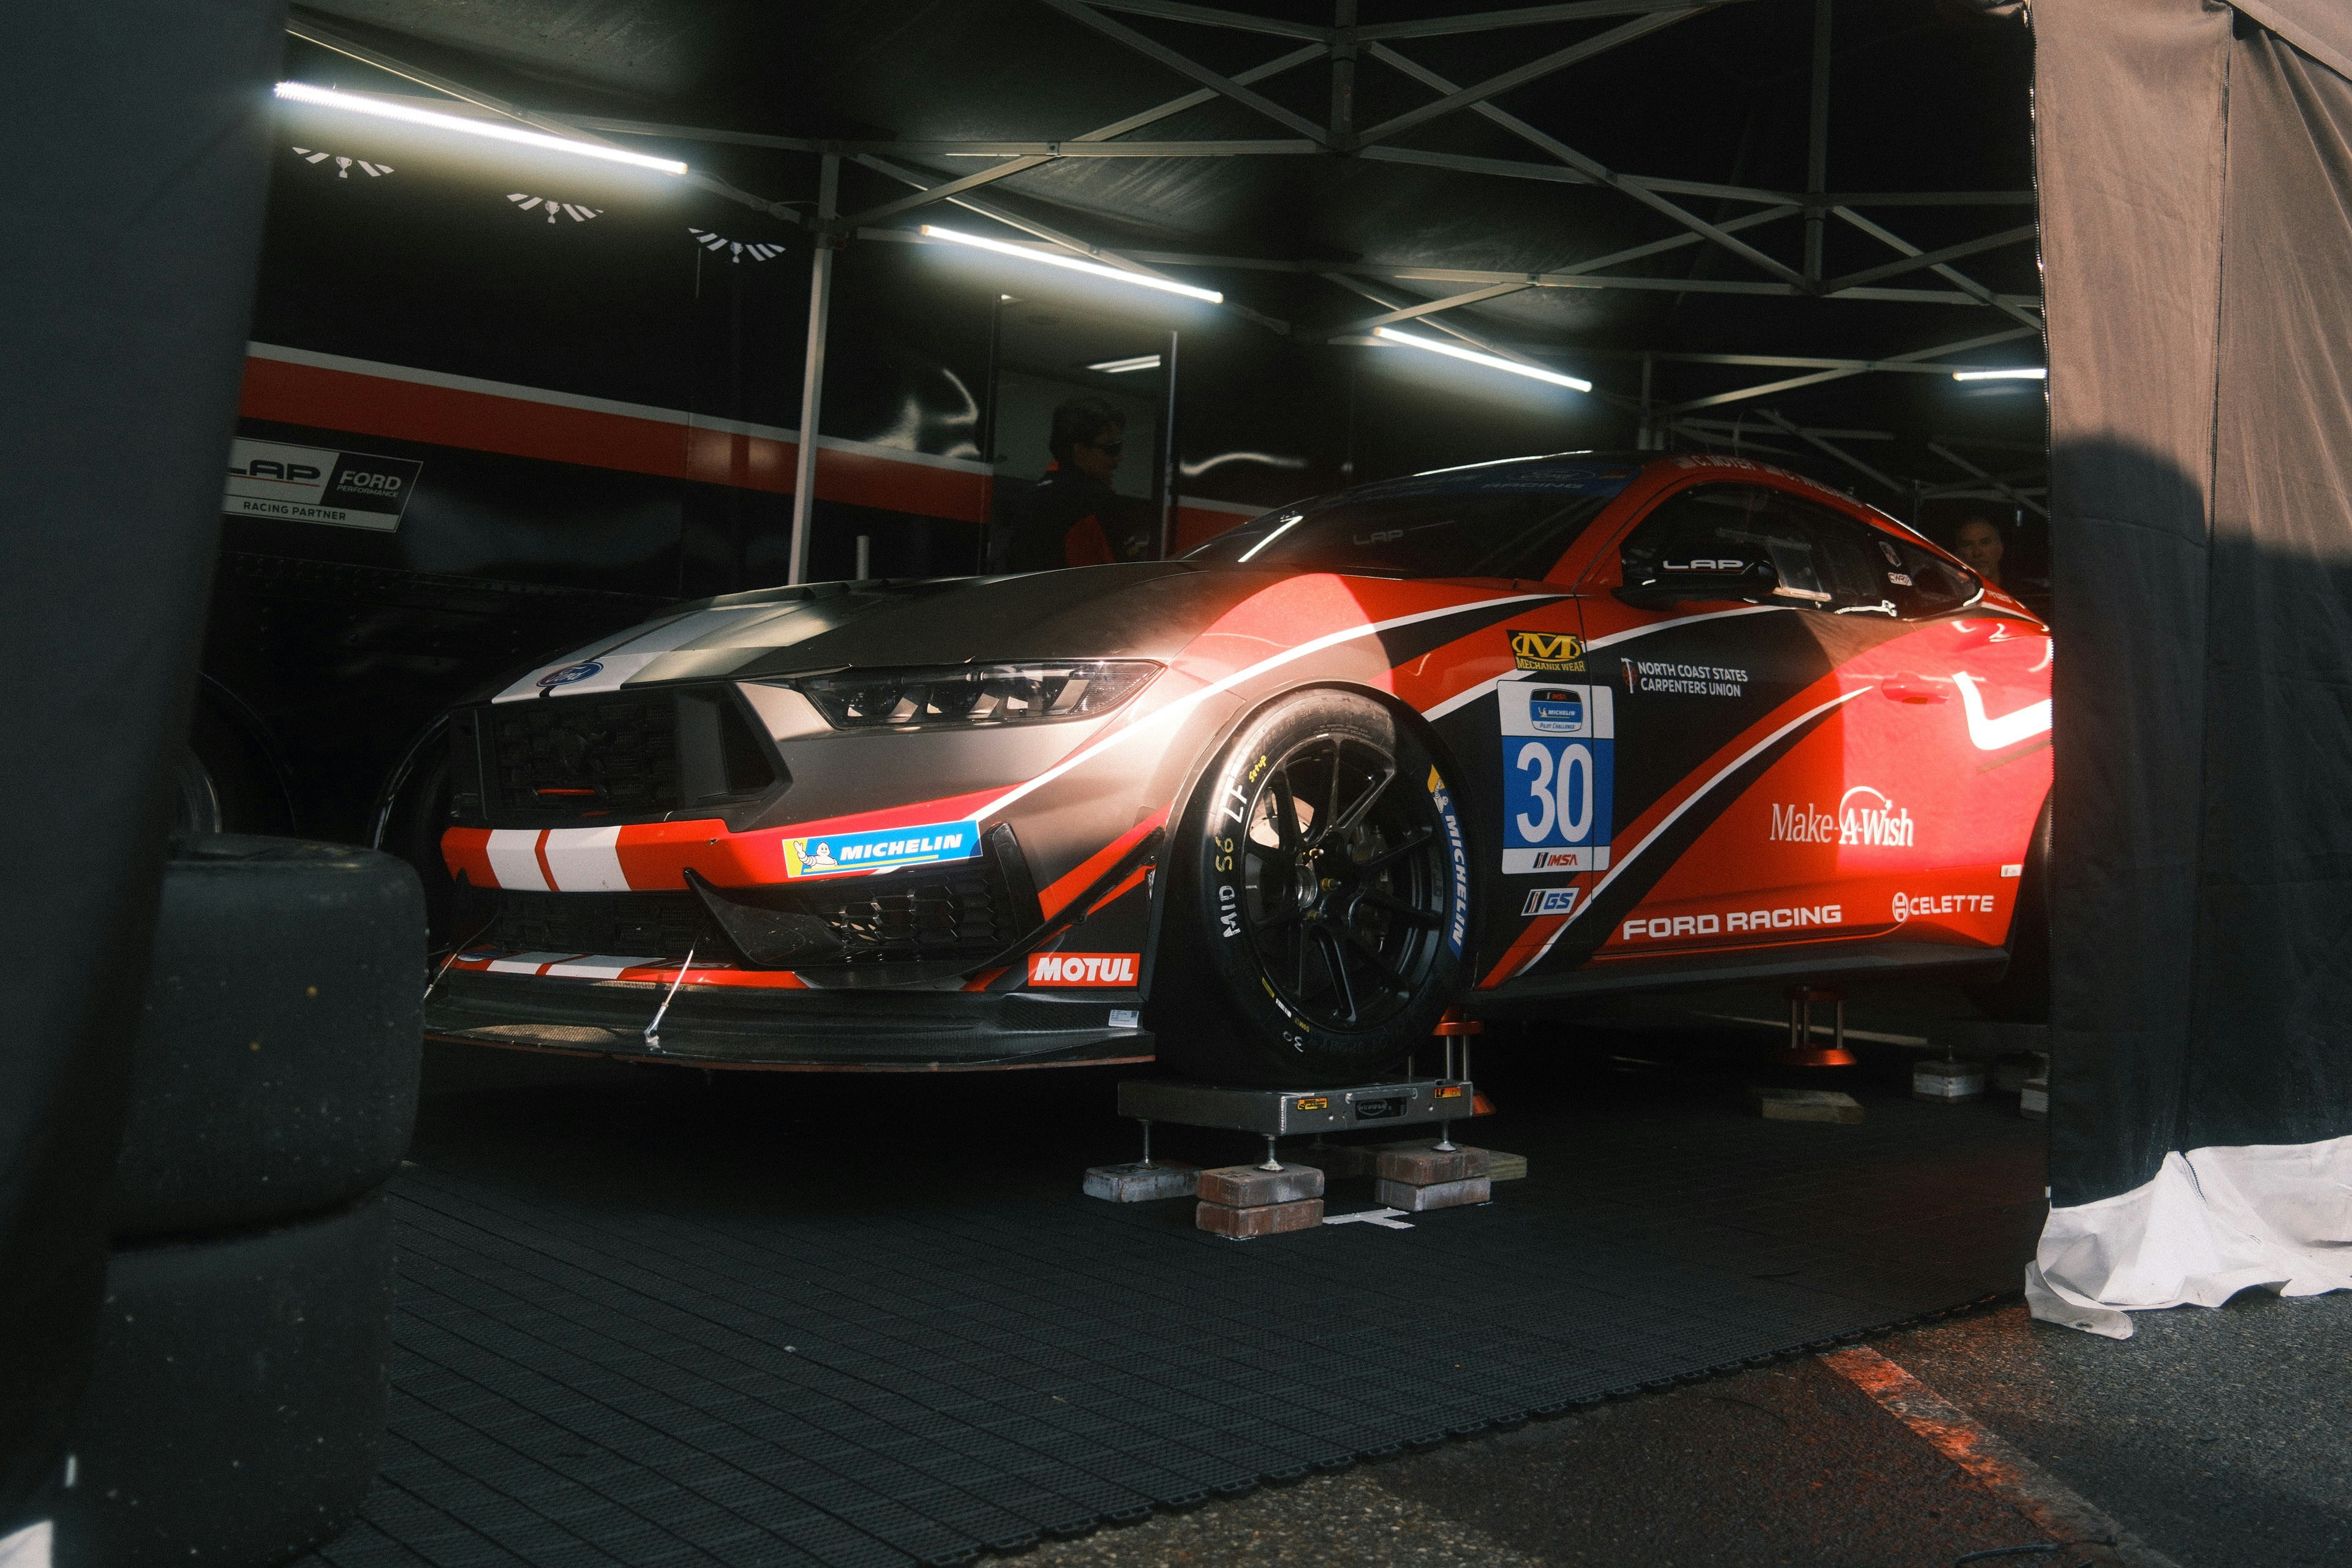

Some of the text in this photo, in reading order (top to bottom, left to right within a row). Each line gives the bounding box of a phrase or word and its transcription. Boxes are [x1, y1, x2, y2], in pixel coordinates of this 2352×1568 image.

[339, 470, 401, 490] FORD
[337, 484, 398, 498] PERFORMANCE
[244, 501, 346, 521] RACING PARTNER
[1354, 529, 1404, 545] LAP
[1662, 559, 1743, 569] LAP
[1517, 657, 1586, 672] MECHANIX WEAR
[1637, 662, 1747, 682] NORTH COAST STATES
[1640, 677, 1741, 697] CARPENTERS UNION
[1516, 742, 1593, 843] 30
[1221, 785, 1247, 823] LF
[1770, 801, 1913, 846] Make-A-Wish
[839, 834, 963, 861] MICHELIN
[1547, 854, 1578, 866] IMSA
[1444, 815, 1470, 946] MICHELIN
[1218, 884, 1242, 938] MID
[1543, 893, 1574, 910] GS
[1909, 895, 1994, 914] CELETTE
[1623, 905, 1842, 940] FORD RACING
[1034, 957, 1134, 981] MOTUL
[1436, 1088, 1445, 1098] LF
